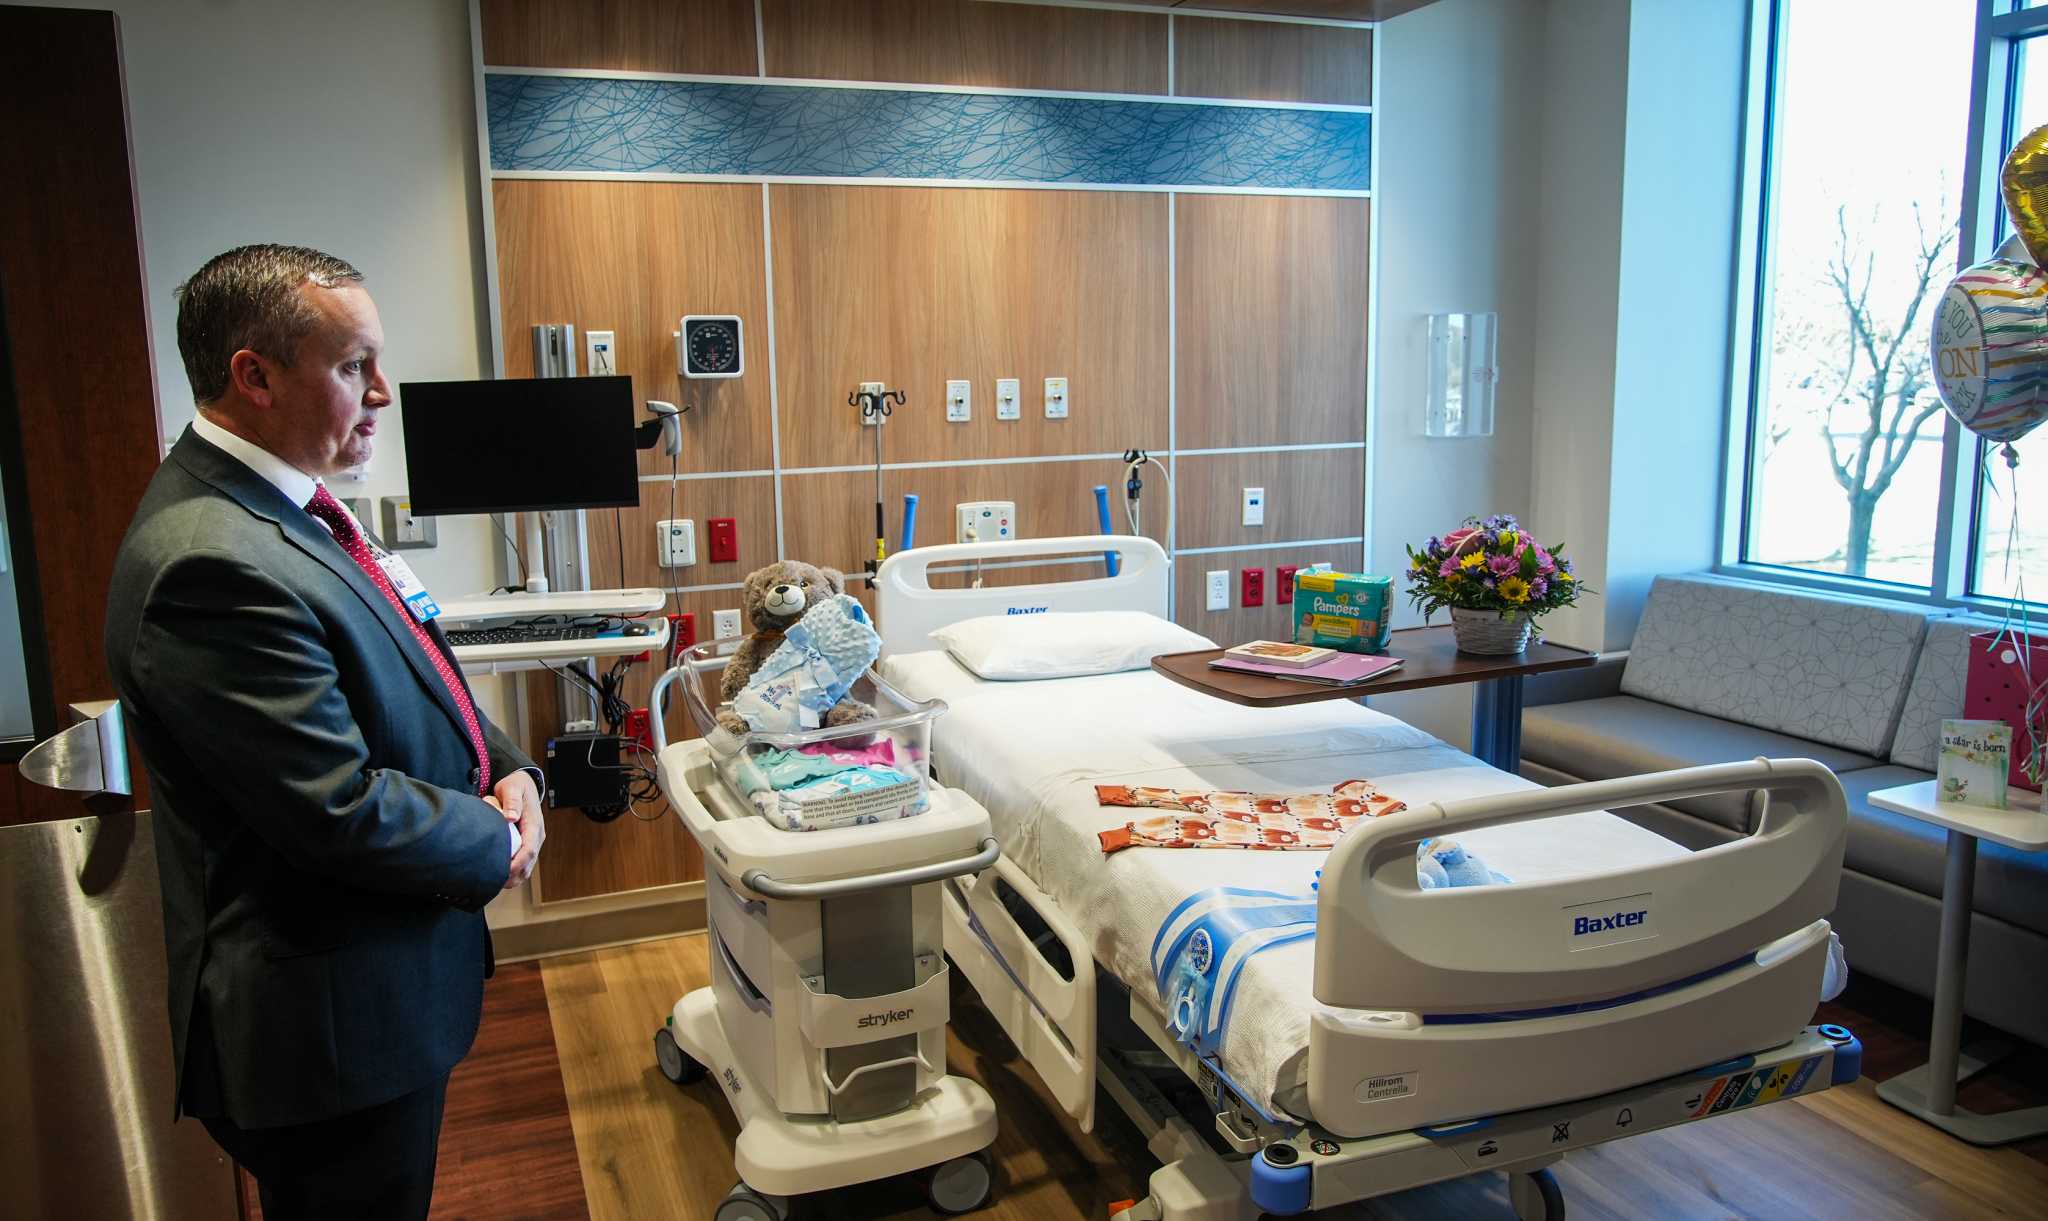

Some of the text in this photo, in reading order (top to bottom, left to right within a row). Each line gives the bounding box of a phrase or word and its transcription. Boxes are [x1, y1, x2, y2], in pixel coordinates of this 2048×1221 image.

[1948, 300, 1974, 339] YOU
[1007, 606, 1048, 615] Baxter
[1313, 596, 1360, 616] Pampers
[1952, 736, 1971, 747] star
[1973, 739, 1981, 751] is
[1983, 739, 2006, 753] born
[1574, 910, 1648, 936] Baxter
[857, 1008, 914, 1029] stryker
[1368, 1076, 1404, 1089] Hillrom
[1367, 1085, 1409, 1099] Centrella
